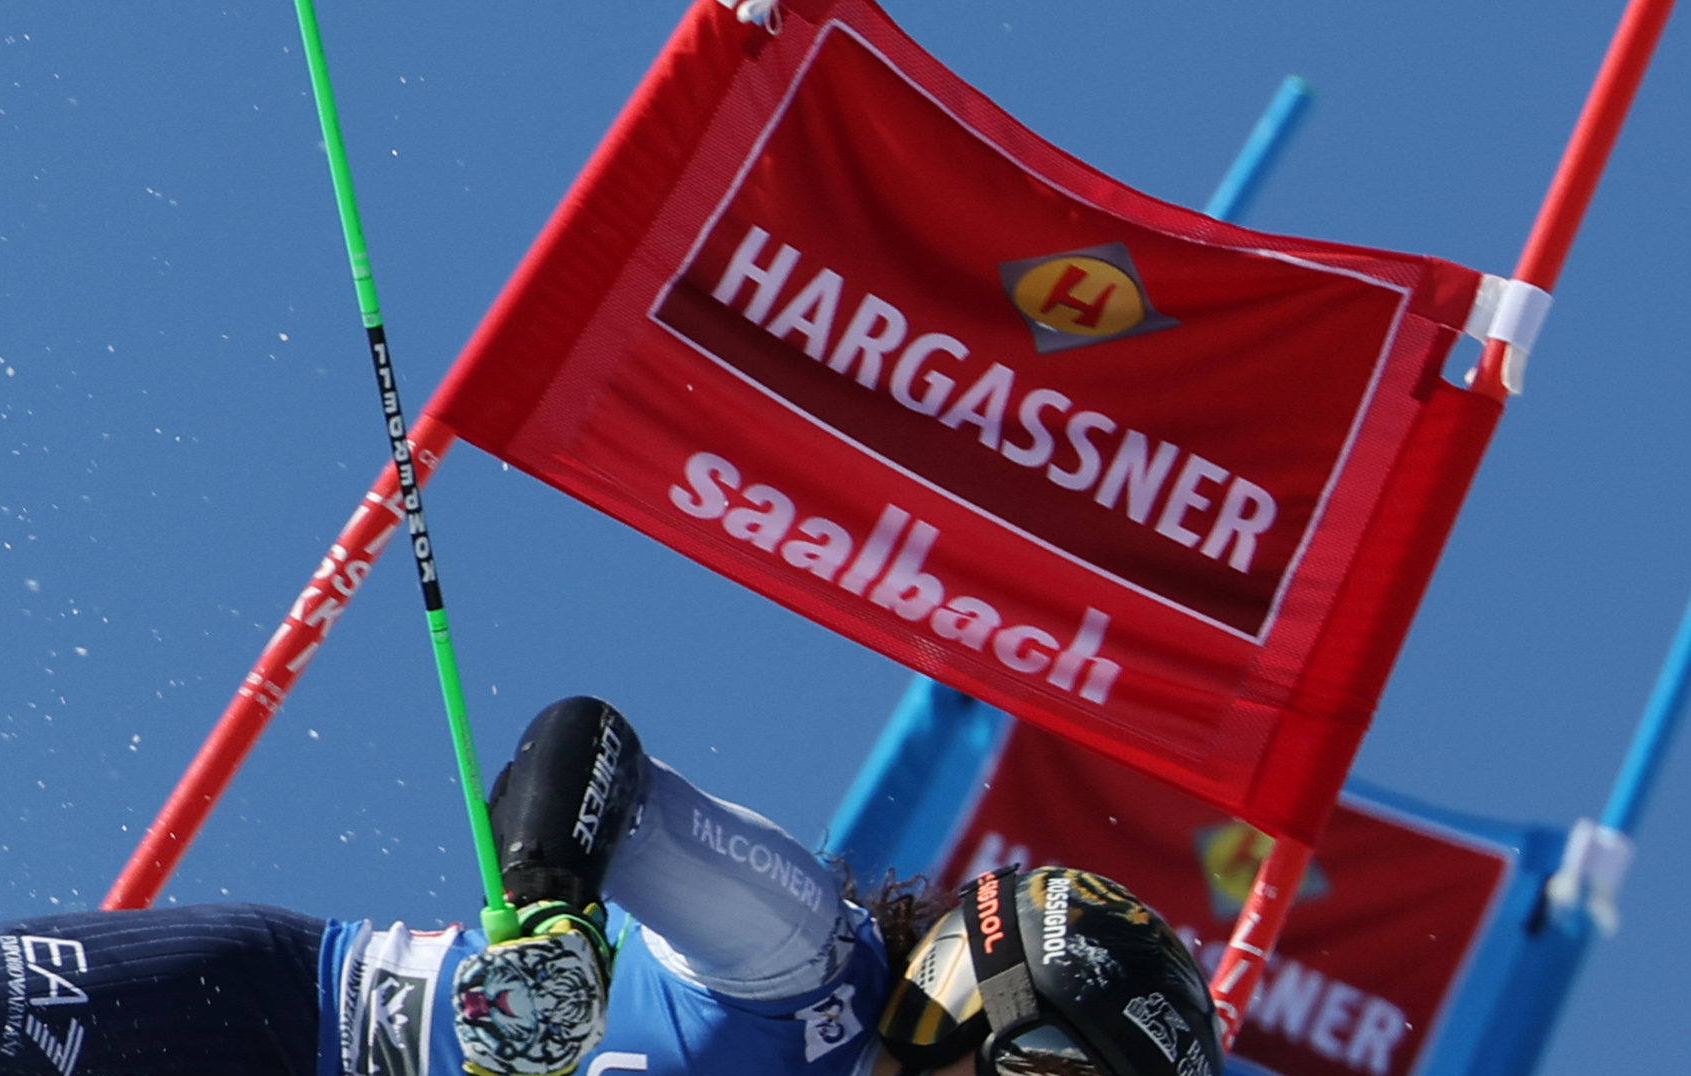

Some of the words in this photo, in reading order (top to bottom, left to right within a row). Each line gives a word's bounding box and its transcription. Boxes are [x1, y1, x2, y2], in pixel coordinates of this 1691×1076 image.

[373, 342, 436, 583] KOMPERDELL
[711, 226, 1277, 574] HARGASSNER
[668, 452, 1122, 705] saalbach
[572, 726, 623, 855] DAINESE
[691, 809, 823, 912] FALCONERI
[1042, 878, 1071, 965] ROSSIGNOL
